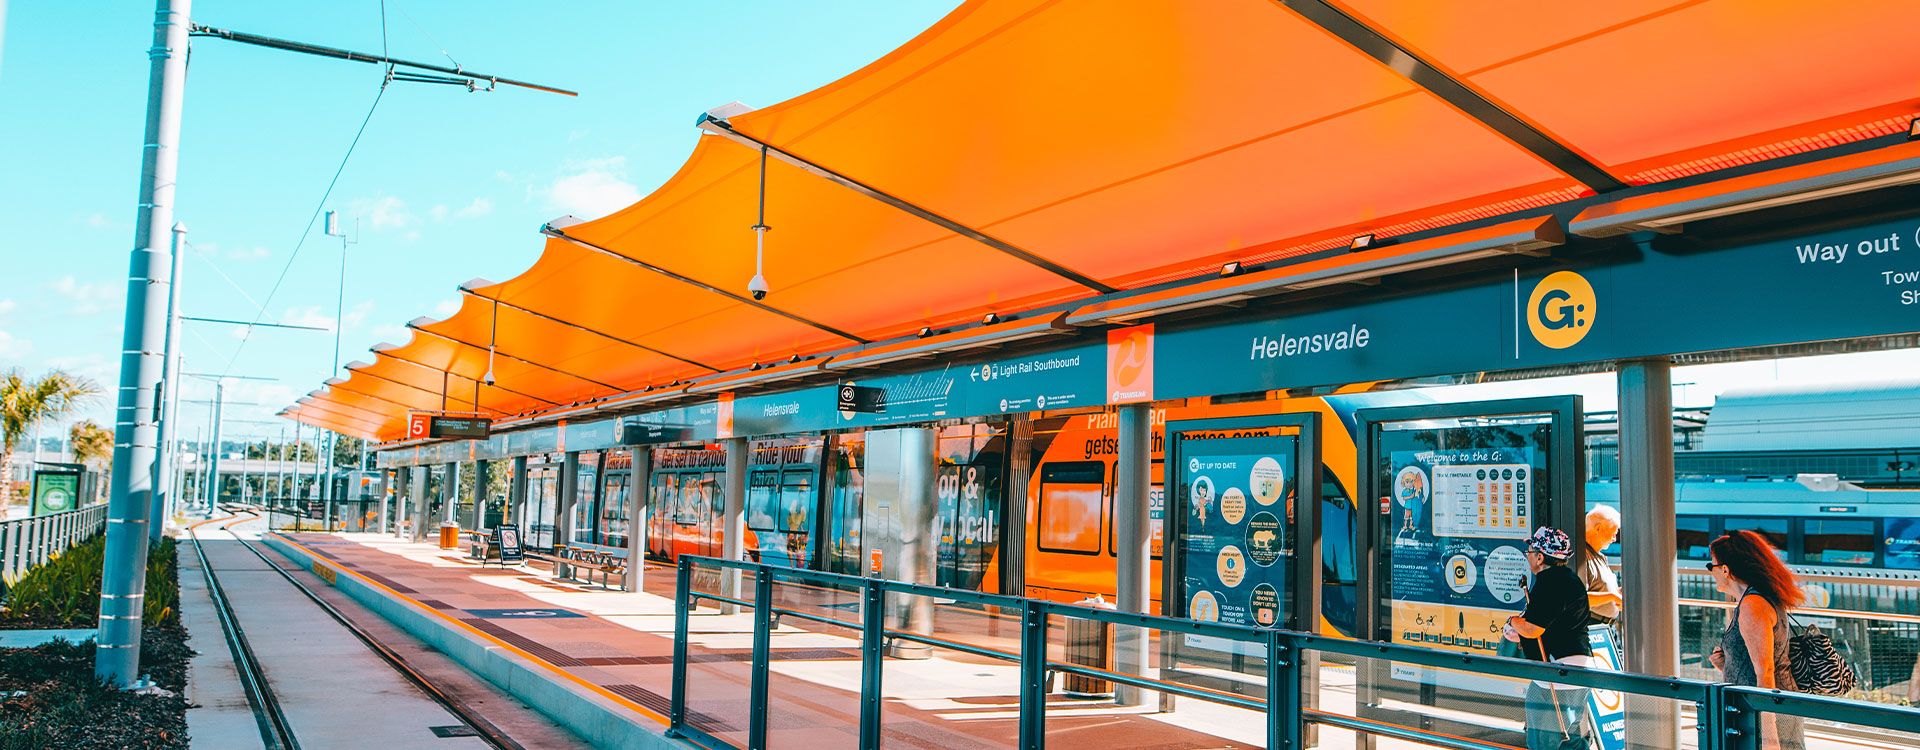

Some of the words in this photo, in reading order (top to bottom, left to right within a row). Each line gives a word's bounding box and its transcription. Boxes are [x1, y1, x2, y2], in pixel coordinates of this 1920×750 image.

[1796, 243, 1848, 264] Way
[1857, 233, 1900, 255] out
[1250, 324, 1370, 360] Helensvale
[1000, 365, 1018, 377] Light
[1019, 362, 1033, 374] Rail
[1034, 355, 1080, 371] Southbound
[764, 401, 800, 417] Helensvale
[412, 420, 423, 435] 5
[1088, 413, 1117, 429] Plan
[662, 450, 673, 468] Get
[675, 451, 684, 468] set
[688, 450, 697, 467] to
[699, 450, 728, 468] carpoo
[755, 441, 778, 465] Ride
[781, 444, 807, 469] your
[1418, 452, 1456, 463] Welcome
[1460, 452, 1470, 461] to
[1473, 451, 1488, 461] the
[1491, 451, 1502, 461] G:
[965, 467, 978, 499] &
[950, 509, 993, 543] local
